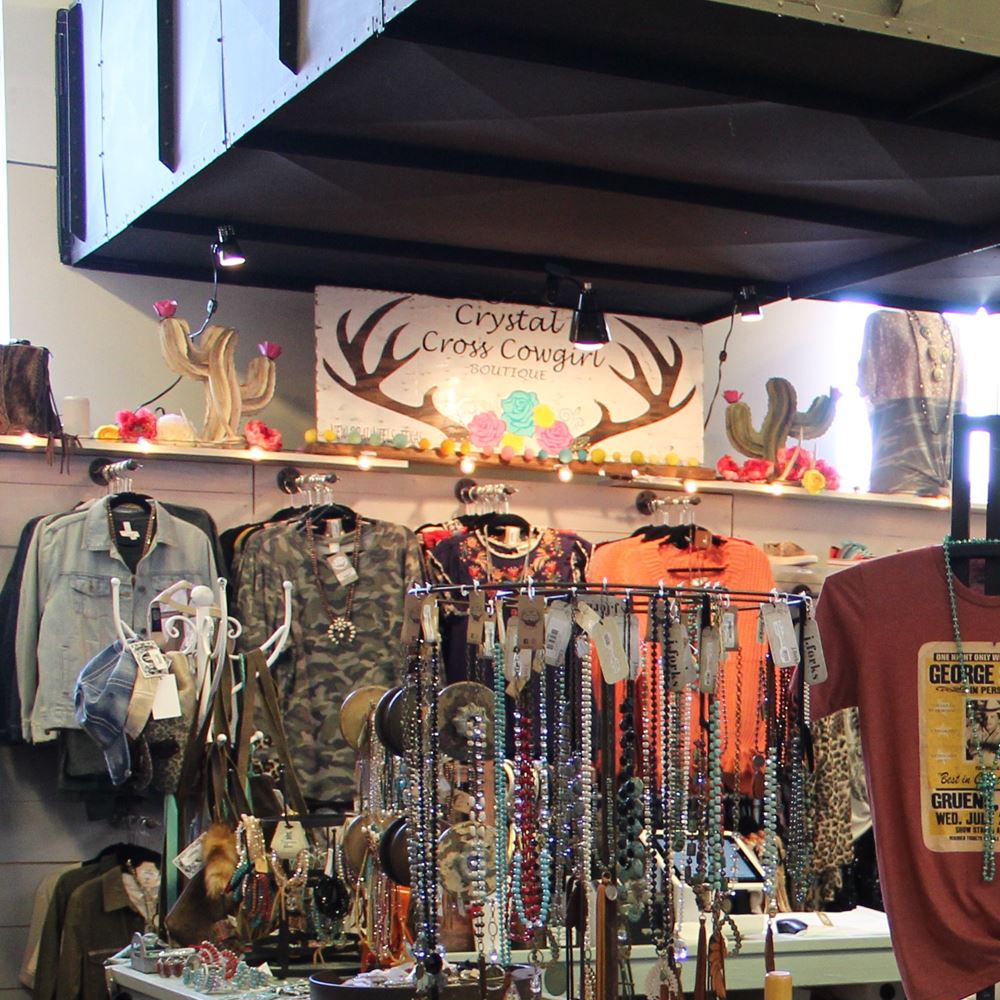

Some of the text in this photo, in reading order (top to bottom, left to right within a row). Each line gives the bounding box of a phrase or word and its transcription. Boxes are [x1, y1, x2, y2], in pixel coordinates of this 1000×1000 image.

[455, 303, 566, 335] Crystal
[422, 330, 606, 373] Cross Cowgirl
[469, 363, 547, 382] BOUTIQUE
[929, 663, 994, 685] GEORGE
[962, 774, 971, 784] in
[935, 812, 962, 825] WED.
[966, 812, 994, 825] JUL
